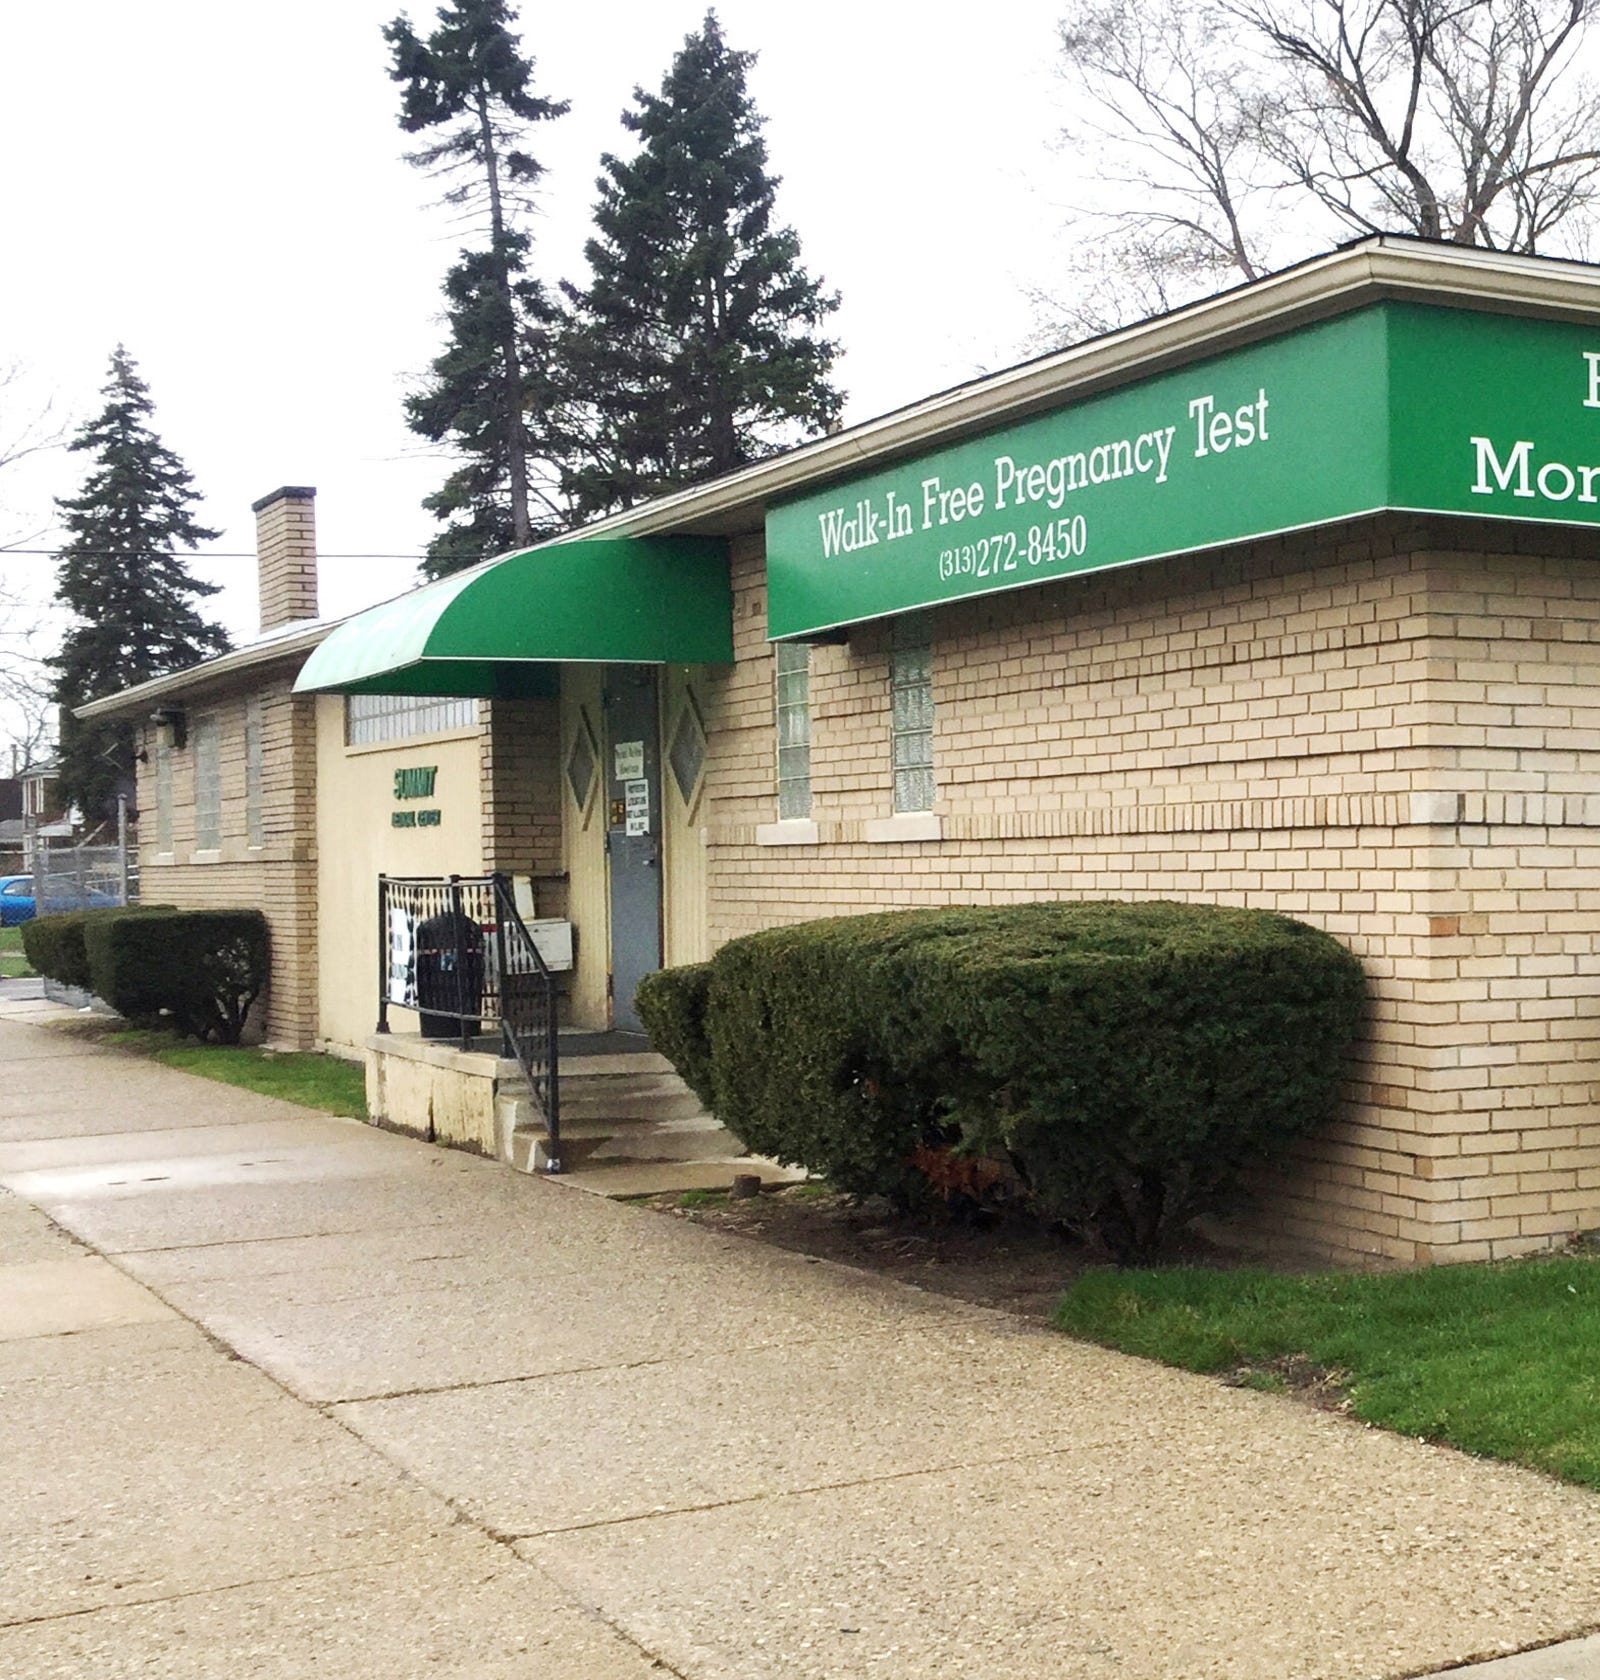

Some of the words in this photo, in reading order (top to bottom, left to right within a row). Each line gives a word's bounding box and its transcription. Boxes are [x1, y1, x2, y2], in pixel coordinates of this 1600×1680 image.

[817, 490, 914, 559] Walk-In
[920, 475, 985, 530] Free
[994, 426, 1176, 509] Pregnancy
[1188, 387, 1270, 458] Test
[938, 515, 1088, 581] (313)272-8450
